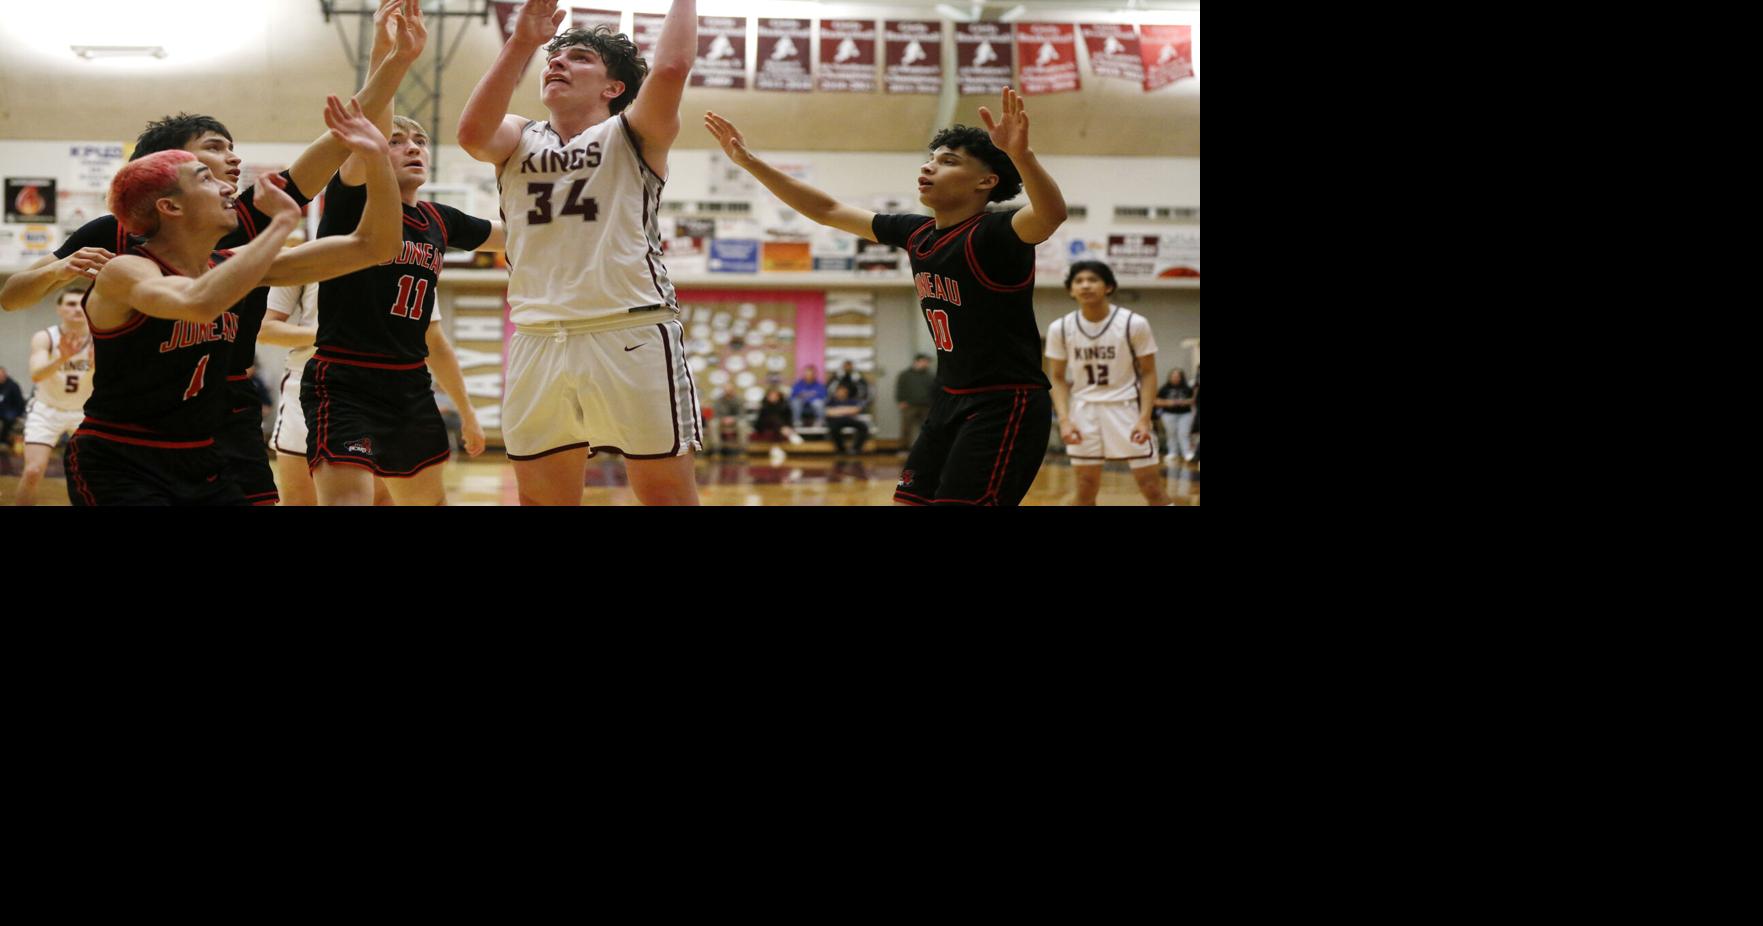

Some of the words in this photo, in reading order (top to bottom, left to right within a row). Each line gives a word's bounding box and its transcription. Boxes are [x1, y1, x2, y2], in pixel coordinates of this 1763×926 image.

[520, 141, 602, 174] KINGS
[527, 178, 599, 226] 34
[390, 274, 429, 321] 11
[926, 308, 954, 353] 10
[1074, 346, 1116, 361] KINGS
[65, 375, 79, 394] 5
[182, 354, 210, 401] 1
[1084, 364, 1109, 386] 12
